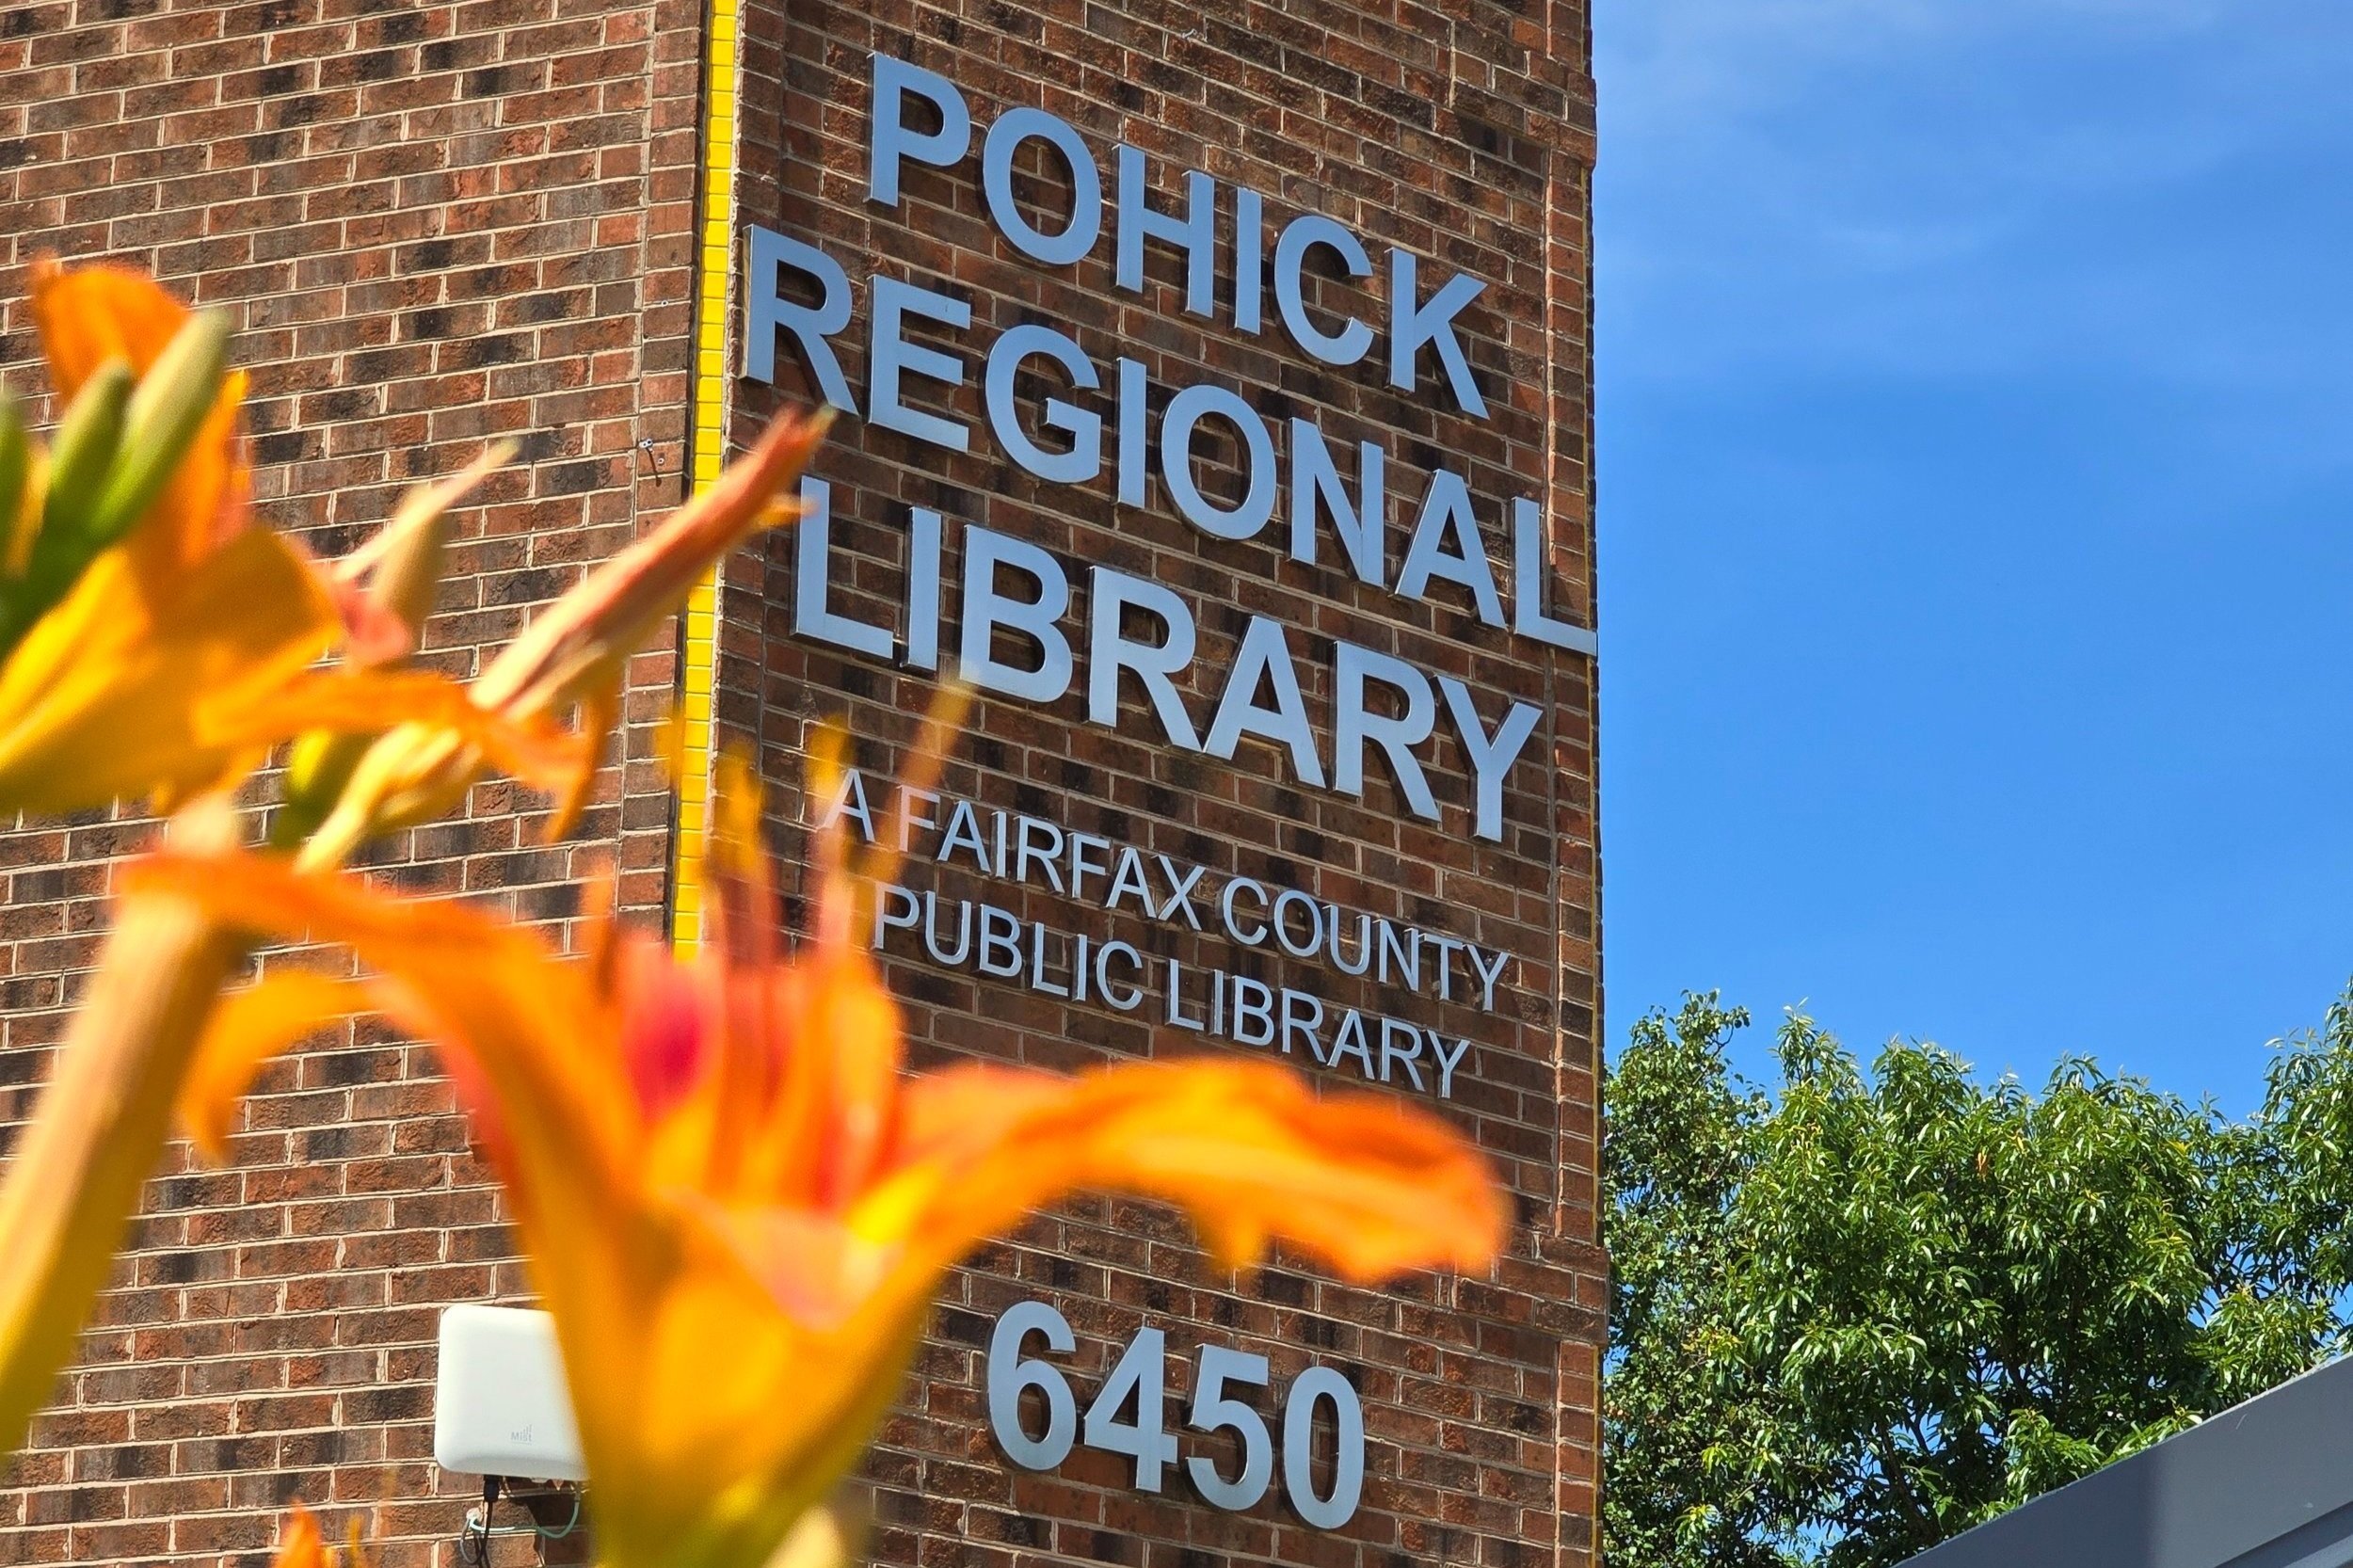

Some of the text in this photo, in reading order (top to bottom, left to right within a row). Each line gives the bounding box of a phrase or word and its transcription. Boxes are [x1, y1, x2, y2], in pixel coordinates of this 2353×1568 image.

[866, 52, 1489, 420] POHICK
[742, 224, 1598, 655] REGIONAL
[792, 476, 1544, 841] LIBRARY
[821, 767, 1509, 1012] A FAIRFAX COUNTY
[873, 881, 1470, 1099] PUBLIC LIBRARY
[510, 1427, 533, 1442] Mist
[984, 1300, 1365, 1529] 6450
